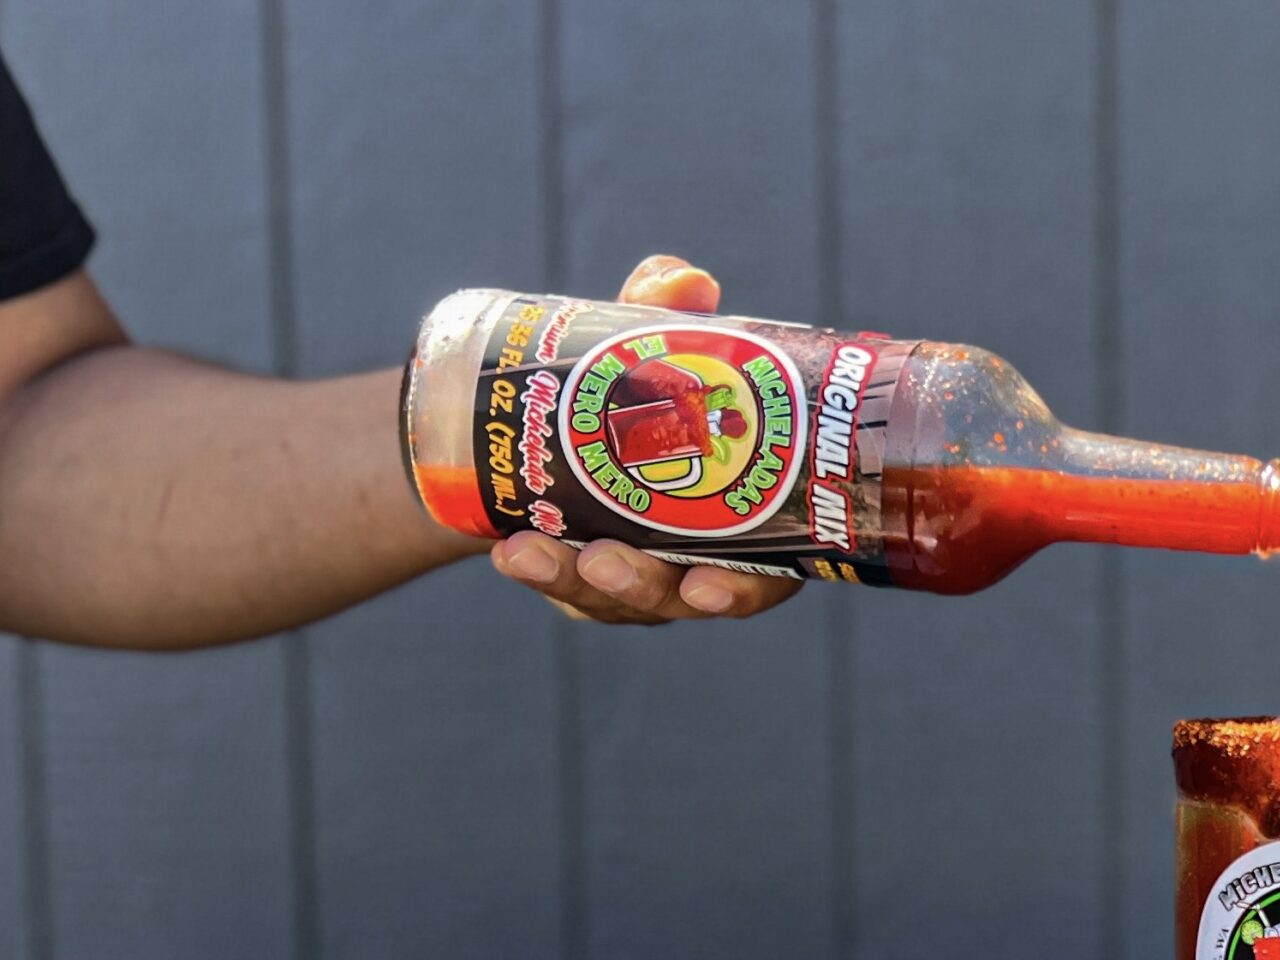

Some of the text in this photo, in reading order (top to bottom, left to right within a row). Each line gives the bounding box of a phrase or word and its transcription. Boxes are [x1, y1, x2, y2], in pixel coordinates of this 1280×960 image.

[490, 379, 516, 416] OZ.
[496, 348, 523, 374] FL.
[485, 422, 516, 474] (750
[519, 370, 560, 495] Michelada
[571, 334, 669, 513] EL MERO MERO
[725, 355, 791, 516] MICHELADAS
[814, 346, 873, 479] ORIGINAL
[812, 484, 851, 550] MIX
